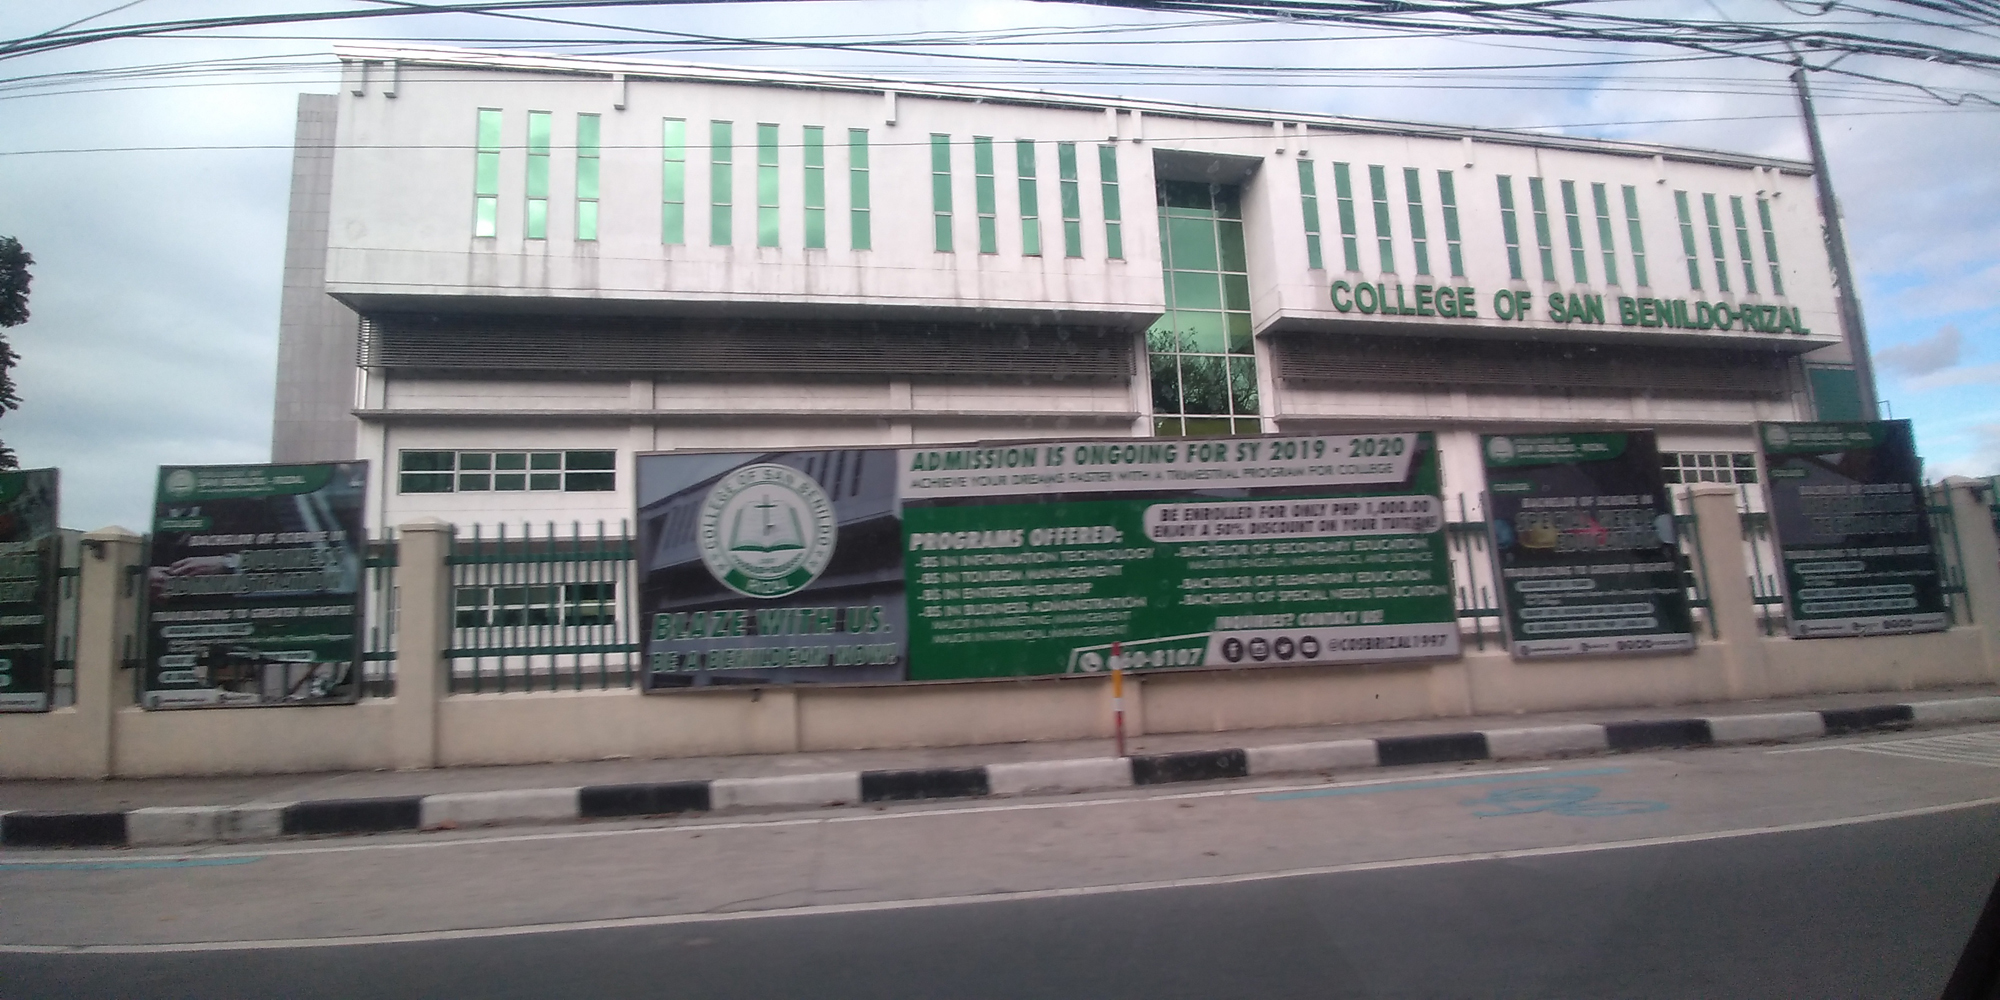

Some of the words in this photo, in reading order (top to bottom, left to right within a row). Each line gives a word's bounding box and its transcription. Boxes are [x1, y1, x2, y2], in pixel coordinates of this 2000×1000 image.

[1331, 280, 1477, 318] COLLEGE
[1494, 289, 1532, 320] OF
[1548, 292, 1605, 324] SAN
[1619, 297, 1811, 335] BENILDO-RIZAL
[910, 448, 1037, 471] ADMISSION
[1046, 446, 1065, 467] IS
[1075, 444, 1177, 466] ONGOING
[1186, 443, 1228, 463] FOR
[1235, 442, 1261, 462] SY
[1270, 440, 1326, 460] 2019
[1349, 437, 1405, 457] 2020
[910, 477, 967, 489] ACHIEVE
[972, 475, 1007, 487] YOUR
[1012, 473, 1065, 485] DREAMS
[1069, 471, 1112, 482] FASTER
[1118, 470, 1148, 481] WITH
[1167, 468, 1239, 480] TRIMESTRIAL
[1246, 466, 1305, 477] PROGRAM
[1309, 465, 1334, 476] FOR
[1340, 463, 1394, 475] COLLEGE
[1160, 508, 1179, 521] BE
[1183, 506, 1253, 521] ENROLLED
[1259, 505, 1287, 518] FOR
[1292, 503, 1328, 517] ONLY
[1331, 502, 1360, 516] PHP
[1366, 500, 1430, 517] 1,000.00
[1153, 523, 1197, 538] ENJOY
[1201, 523, 1210, 536] A
[1214, 522, 1245, 536] 50%
[1249, 520, 1314, 535] DISCOUNT
[1318, 519, 1338, 533] ON
[1342, 518, 1377, 531] YOUR
[909, 529, 1025, 551] PROGRAMS
[1029, 526, 1124, 547] OFFERED:
[1252, 543, 1271, 555] OF
[1273, 540, 1351, 554] SECONDARY
[1354, 538, 1428, 551] EDUCATION
[941, 556, 959, 567] IN
[960, 552, 1058, 567] INFORMATION
[1060, 548, 1155, 561] TECHNOLOGY
[941, 572, 960, 583] IN
[961, 570, 1023, 583] TOURISM
[1025, 565, 1123, 579] MANAGEMENT
[1254, 574, 1274, 587] OF
[1276, 572, 1353, 586] ELEMENTARY
[1356, 569, 1432, 583] EDUCATION
[943, 588, 961, 600] IN
[962, 582, 1093, 599] ENTREPRENEURSHIP
[1254, 591, 1276, 603] OF
[1277, 589, 1328, 602] SPECIAL
[1329, 587, 1371, 600] NEEDS
[1374, 585, 1448, 598] EDUCATION
[943, 605, 961, 616] IN
[963, 602, 1029, 615] BUSINESS
[1032, 597, 1147, 612] ADMINISTRATION
[652, 609, 748, 641] BLAZE
[754, 606, 837, 637] WITH
[844, 605, 893, 635] US.
[652, 652, 679, 674] BE
[681, 650, 699, 672] A
[706, 645, 830, 672] BENILDEAN
